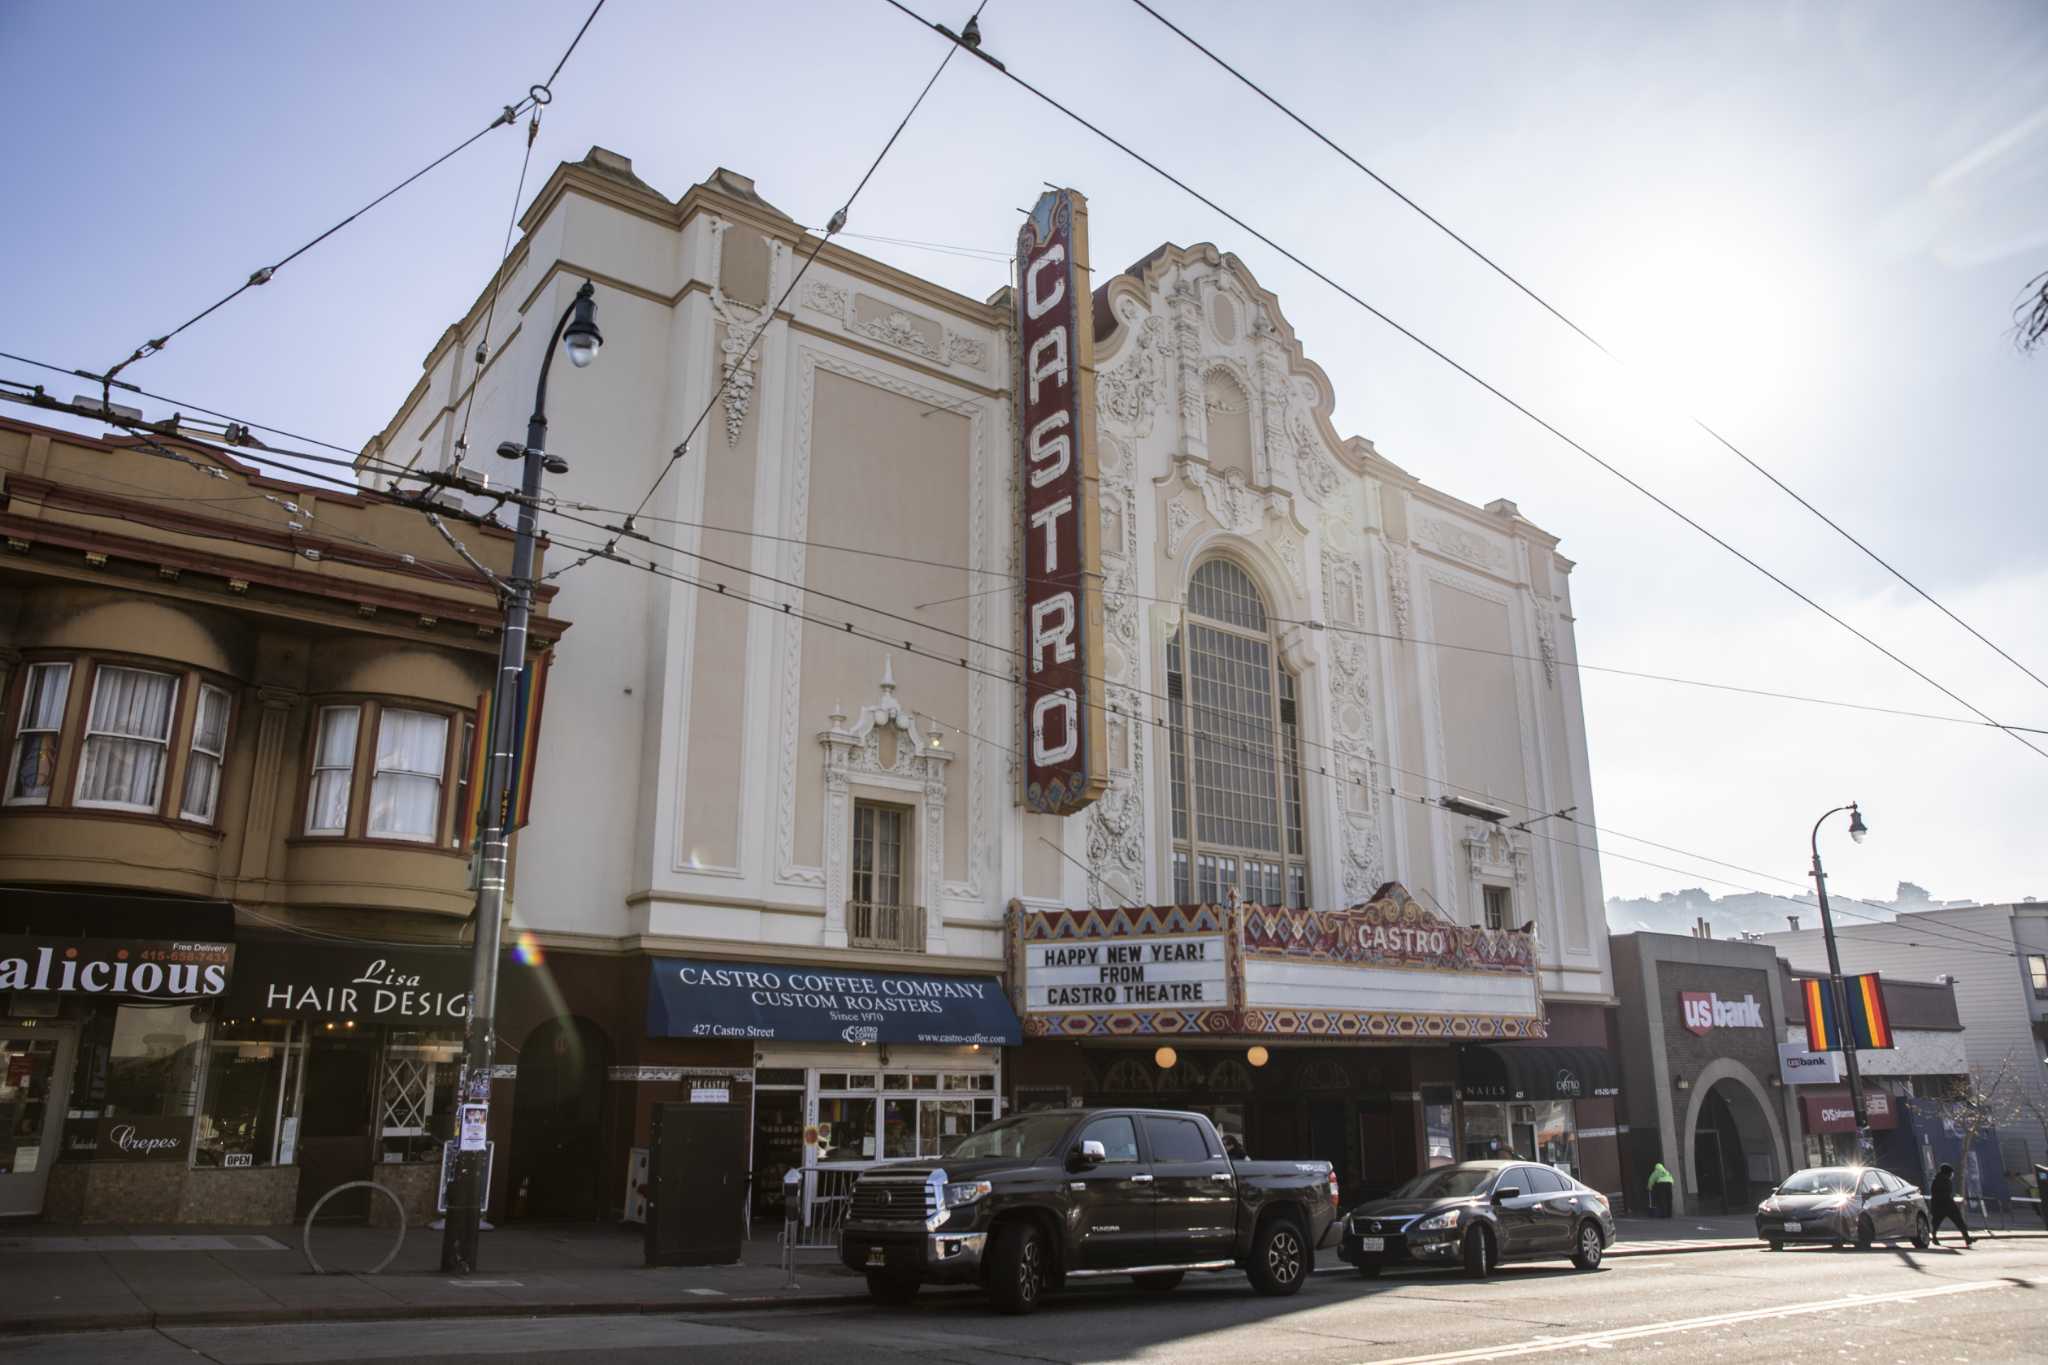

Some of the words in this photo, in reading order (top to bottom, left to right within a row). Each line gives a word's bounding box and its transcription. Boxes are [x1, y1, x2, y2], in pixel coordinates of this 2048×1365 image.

[1026, 243, 1078, 769] CASTRO
[173, 942, 192, 951] Free
[194, 943, 227, 954] Delivery
[1358, 924, 1443, 955] CASTRO
[1044, 947, 1098, 966] HAPPY
[1107, 945, 1141, 964] NEW
[1151, 943, 1205, 961] YEAR!
[0, 946, 227, 995] alicious
[352, 959, 420, 987] Lisa
[1100, 965, 1144, 983] FROM
[679, 967, 781, 989] CASTRO
[788, 974, 878, 995] COFFEE
[881, 979, 985, 999] COMPANY
[1048, 986, 1116, 1005] CASTRO
[1123, 983, 1203, 1002] THEATRE
[266, 983, 359, 1013] HAIR
[373, 989, 467, 1017] DESIG
[751, 991, 838, 1009] CUSTOM
[845, 995, 943, 1013] ROASTERS
[829, 1010, 860, 1021] Since
[692, 1024, 710, 1035] 427
[712, 1024, 745, 1037] Castro
[747, 1025, 775, 1038] Street
[855, 1025, 878, 1033] CASTRO
[855, 1032, 877, 1040] COFFEE
[918, 1033, 1006, 1044] www.castro-coffee.com
[1466, 1085, 1506, 1096] NAILS
[110, 1124, 182, 1156] Crepes
[227, 1155, 250, 1166] OPEN
